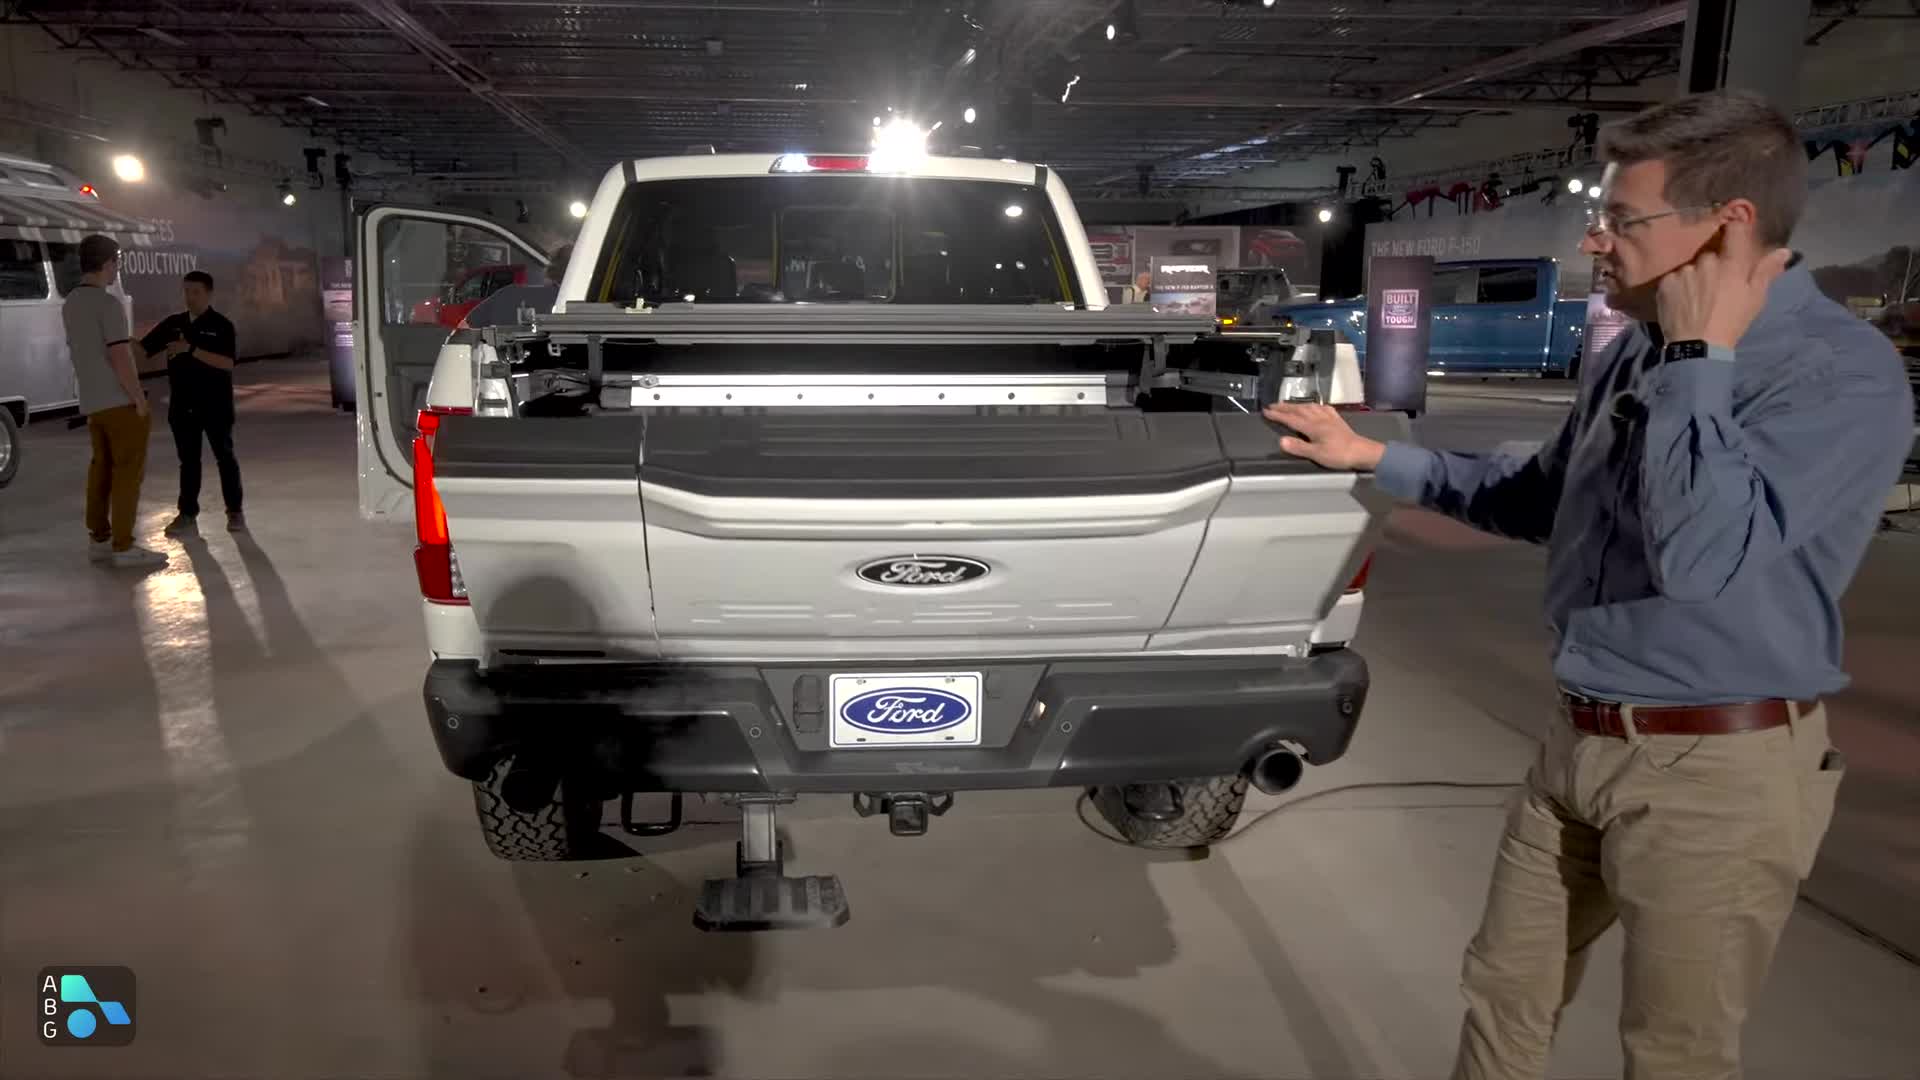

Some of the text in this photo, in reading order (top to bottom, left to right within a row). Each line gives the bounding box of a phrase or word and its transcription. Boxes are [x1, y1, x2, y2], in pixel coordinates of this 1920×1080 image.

[1386, 293, 1415, 304] BUILT
[1385, 316, 1414, 324] TOUGH
[880, 560, 967, 583] Ford
[866, 695, 946, 724] Ford
